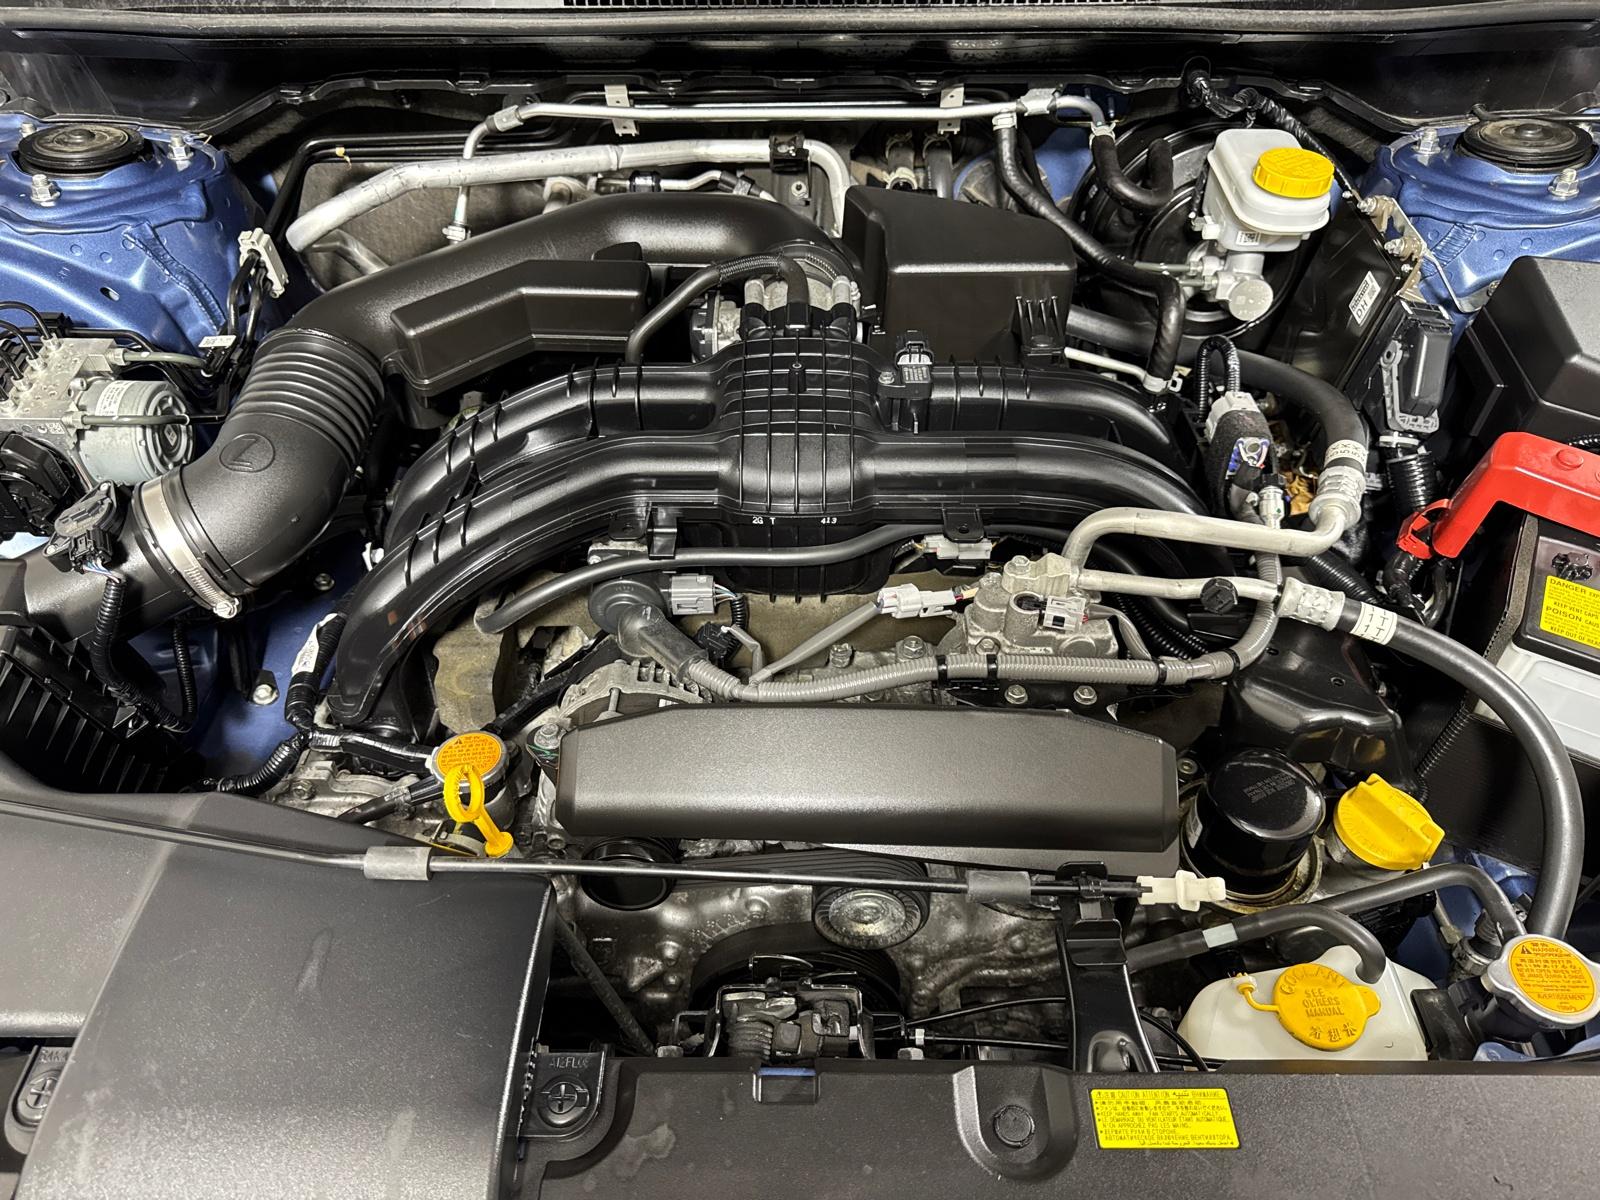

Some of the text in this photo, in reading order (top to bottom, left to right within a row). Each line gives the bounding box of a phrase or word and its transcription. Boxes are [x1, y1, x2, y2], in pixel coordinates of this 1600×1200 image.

[1356, 299, 1368, 318] DH
[1550, 578, 1587, 595] DANGER
[1546, 606, 1582, 622] POISON
[1554, 601, 1568, 609] KEEP
[1569, 605, 1583, 614] VENT
[1550, 626, 1565, 635] KEEP
[1565, 630, 1577, 638] OUT
[1304, 988, 1326, 998] SEE
[1306, 1007, 1344, 1017] MANUAL
